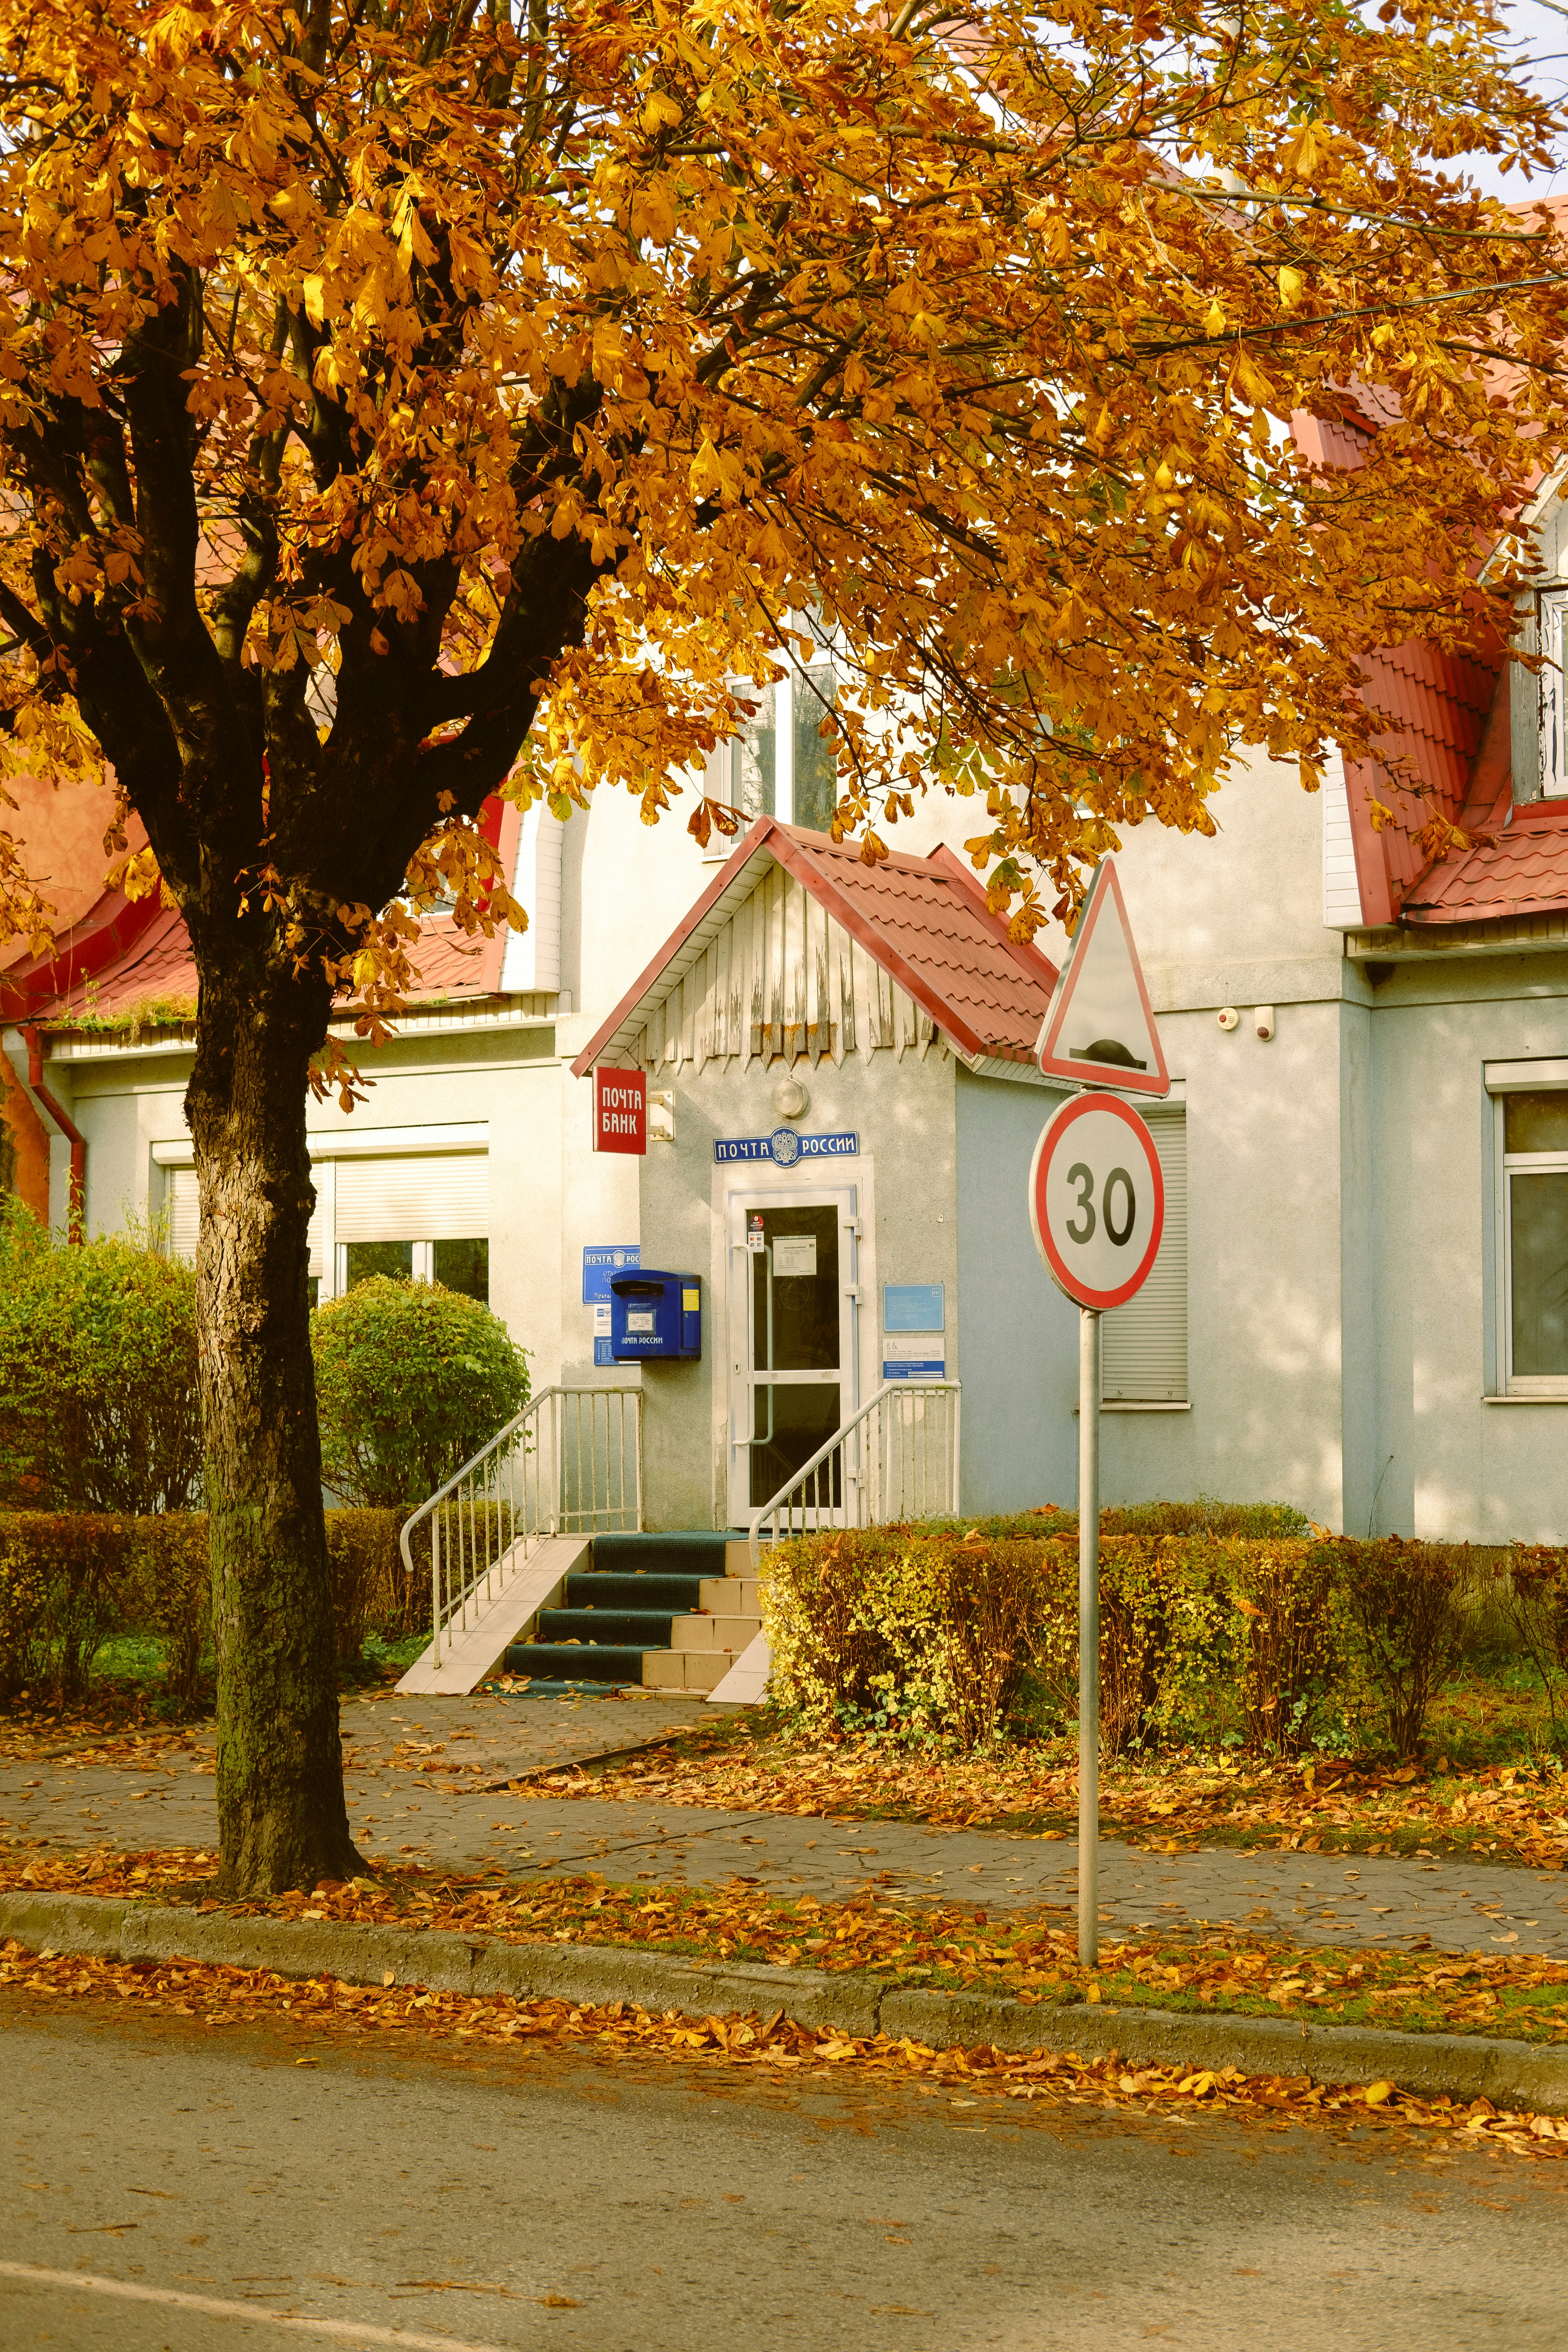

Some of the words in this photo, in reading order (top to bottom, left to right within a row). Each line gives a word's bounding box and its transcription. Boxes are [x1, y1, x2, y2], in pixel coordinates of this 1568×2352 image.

[603, 1087, 642, 1110] ПОЧТА
[603, 1112, 637, 1134] БАНК
[718, 1142, 769, 1158] ПОЧТА
[802, 1137, 854, 1153] РОССИИ
[1066, 1162, 1136, 1246] 30
[586, 1256, 611, 1264] ПОЧТА
